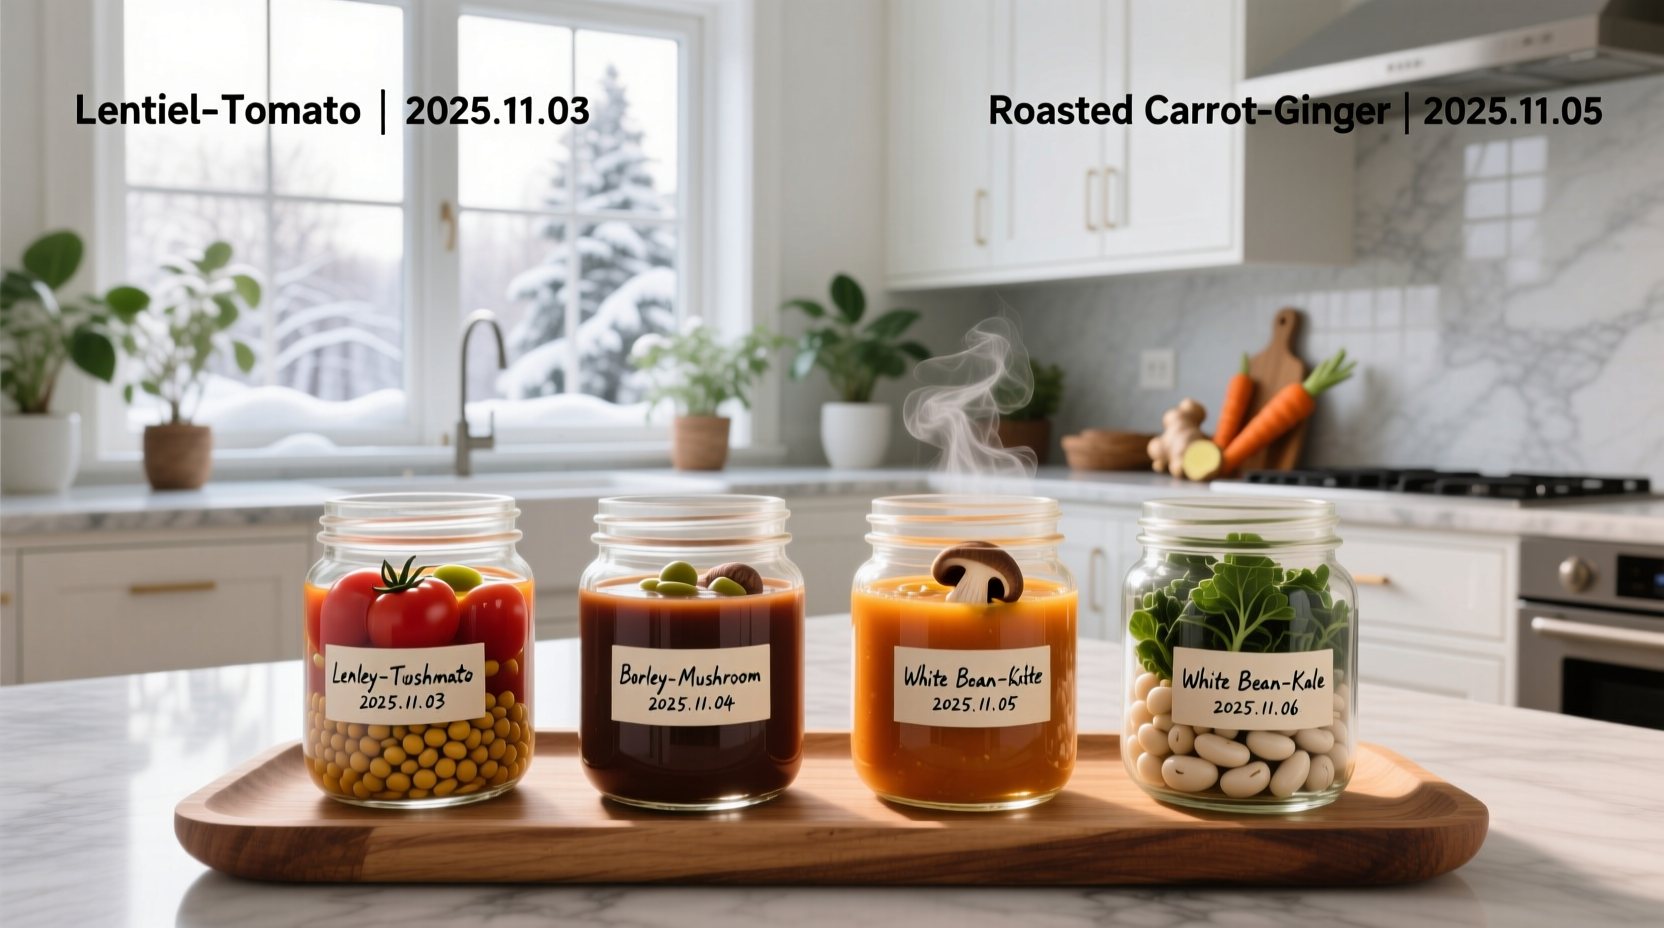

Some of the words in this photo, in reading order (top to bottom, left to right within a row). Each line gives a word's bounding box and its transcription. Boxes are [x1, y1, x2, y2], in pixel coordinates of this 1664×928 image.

[904, 663, 948, 687] White
[1182, 667, 1230, 690] White
[1238, 667, 1326, 692] Bean-Kale
[359, 692, 445, 710] 2025.11.03
[648, 694, 735, 712] 2025.11.04
[932, 695, 1018, 712] 2025.11.05
[1213, 698, 1299, 716] 2025.11.06
